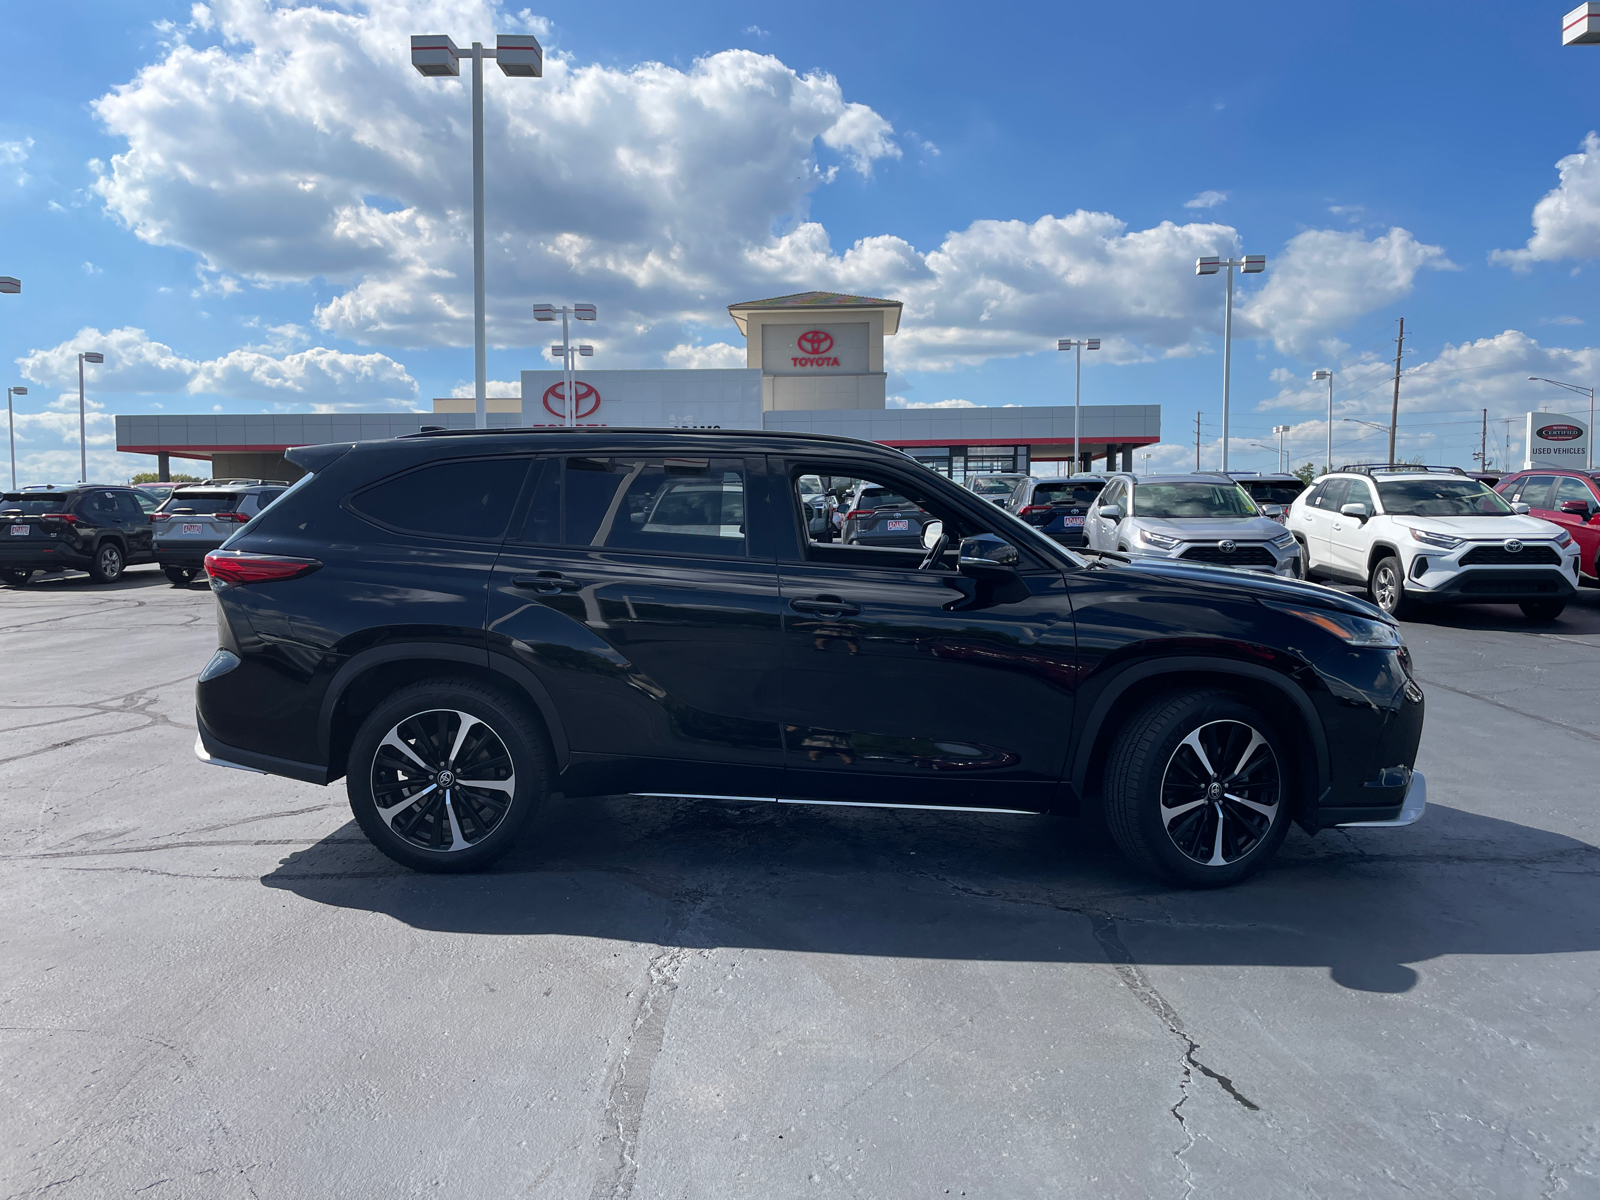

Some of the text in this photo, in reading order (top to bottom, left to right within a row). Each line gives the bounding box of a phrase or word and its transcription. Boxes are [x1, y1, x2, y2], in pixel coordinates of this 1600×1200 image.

[791, 357, 840, 367] TOYOTA
[1532, 447, 1586, 455] USED VEHICLES
[889, 521, 907, 529] ADAMS
[1065, 517, 1084, 525] ADAMS
[184, 525, 201, 533] ADAMS
